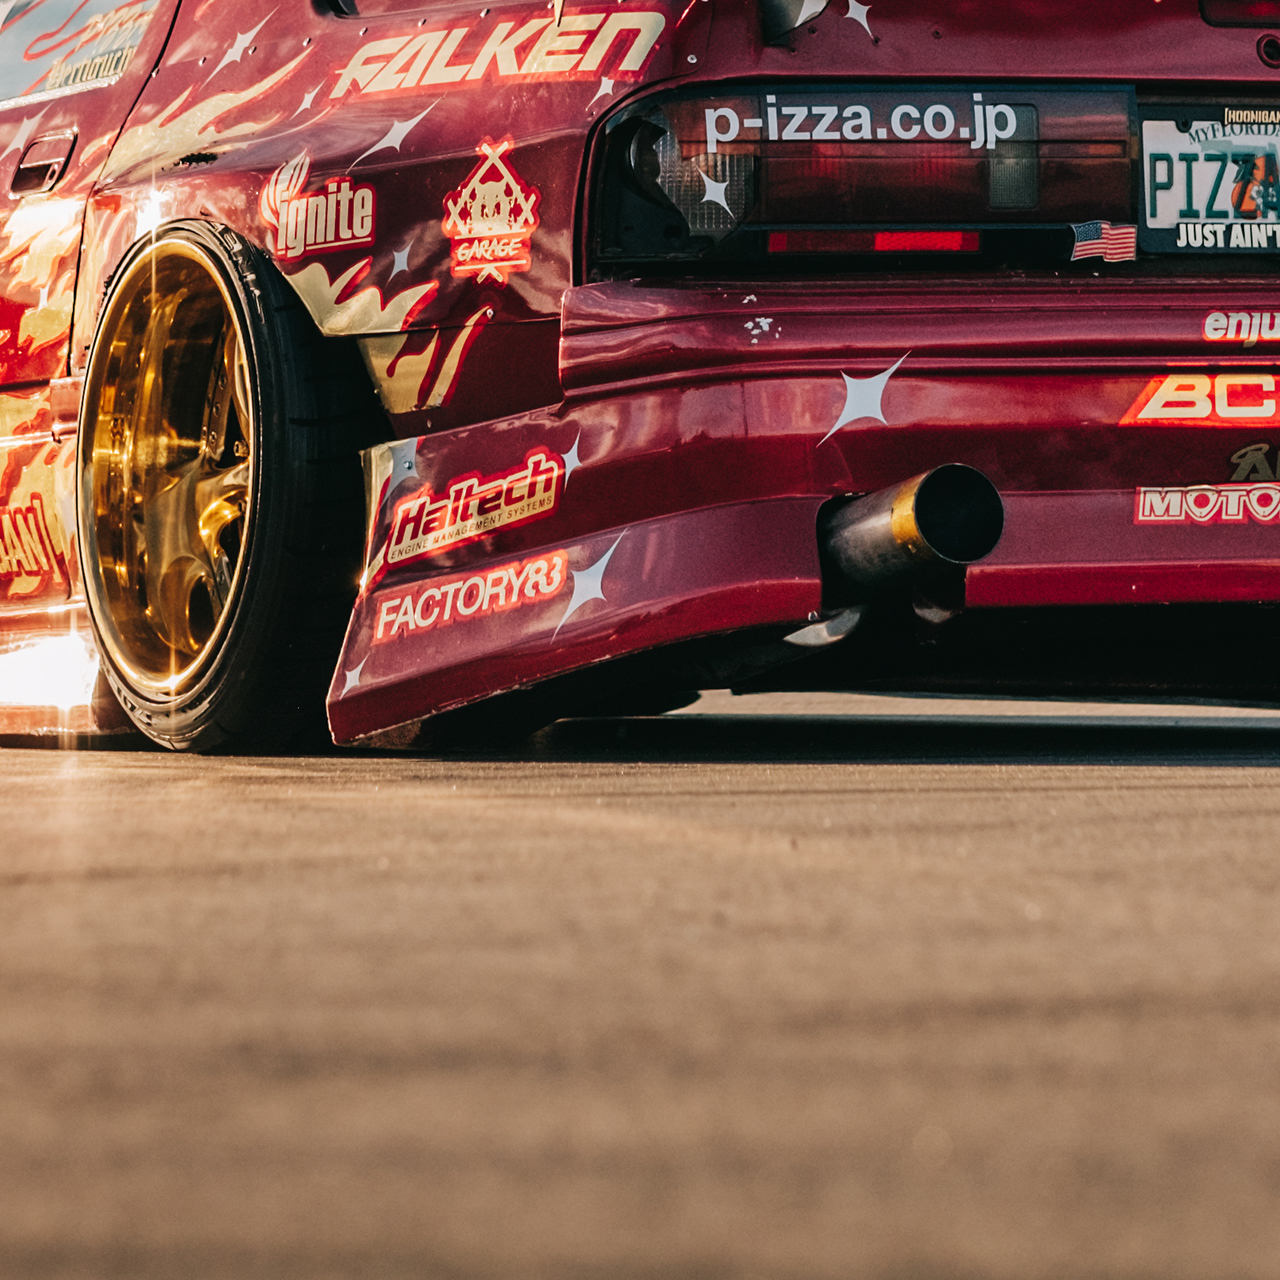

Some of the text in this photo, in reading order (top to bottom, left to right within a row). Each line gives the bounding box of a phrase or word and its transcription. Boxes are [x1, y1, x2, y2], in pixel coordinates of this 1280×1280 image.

[328, 11, 666, 99] FALKEN
[705, 93, 1017, 153] p-izza.co.jp
[277, 181, 373, 258] ignite
[455, 237, 523, 261] GARAGE
[1176, 223, 1226, 248] JUST
[390, 495, 553, 560] ENGINE MANAGEMENT SYSTEMS
[392, 453, 559, 547] Haltech
